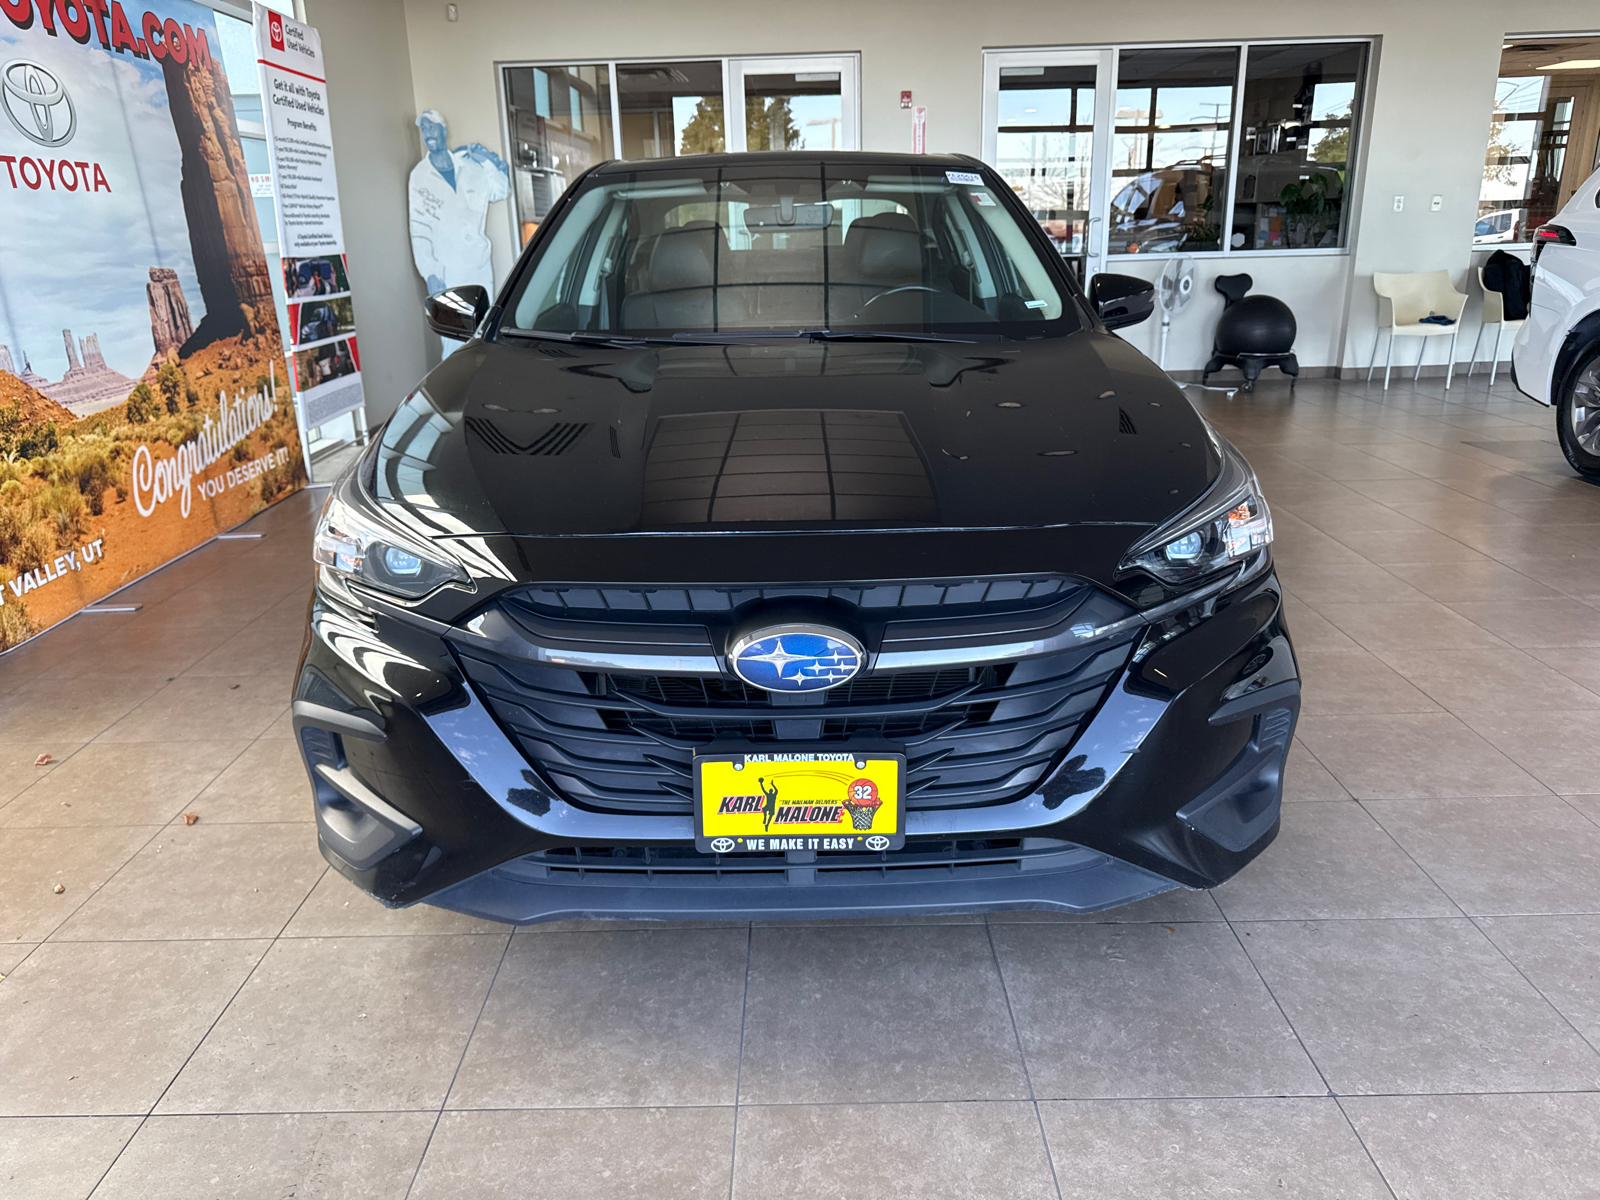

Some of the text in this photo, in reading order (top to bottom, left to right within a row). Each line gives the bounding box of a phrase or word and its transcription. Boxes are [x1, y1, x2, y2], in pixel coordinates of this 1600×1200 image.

[0, 155, 112, 193] TOYOTA
[132, 359, 278, 518] Congratulations!
[197, 446, 290, 501] YOU DESERVE IT!
[8, 550, 81, 598] VALLEY,
[81, 538, 103, 563] UT
[744, 753, 855, 763] KARL MALONE TOYOTA
[854, 785, 872, 800] 32
[718, 795, 765, 814] KARL
[774, 806, 844, 824] MALONE
[746, 838, 854, 850] WE MAKE IT EASY
